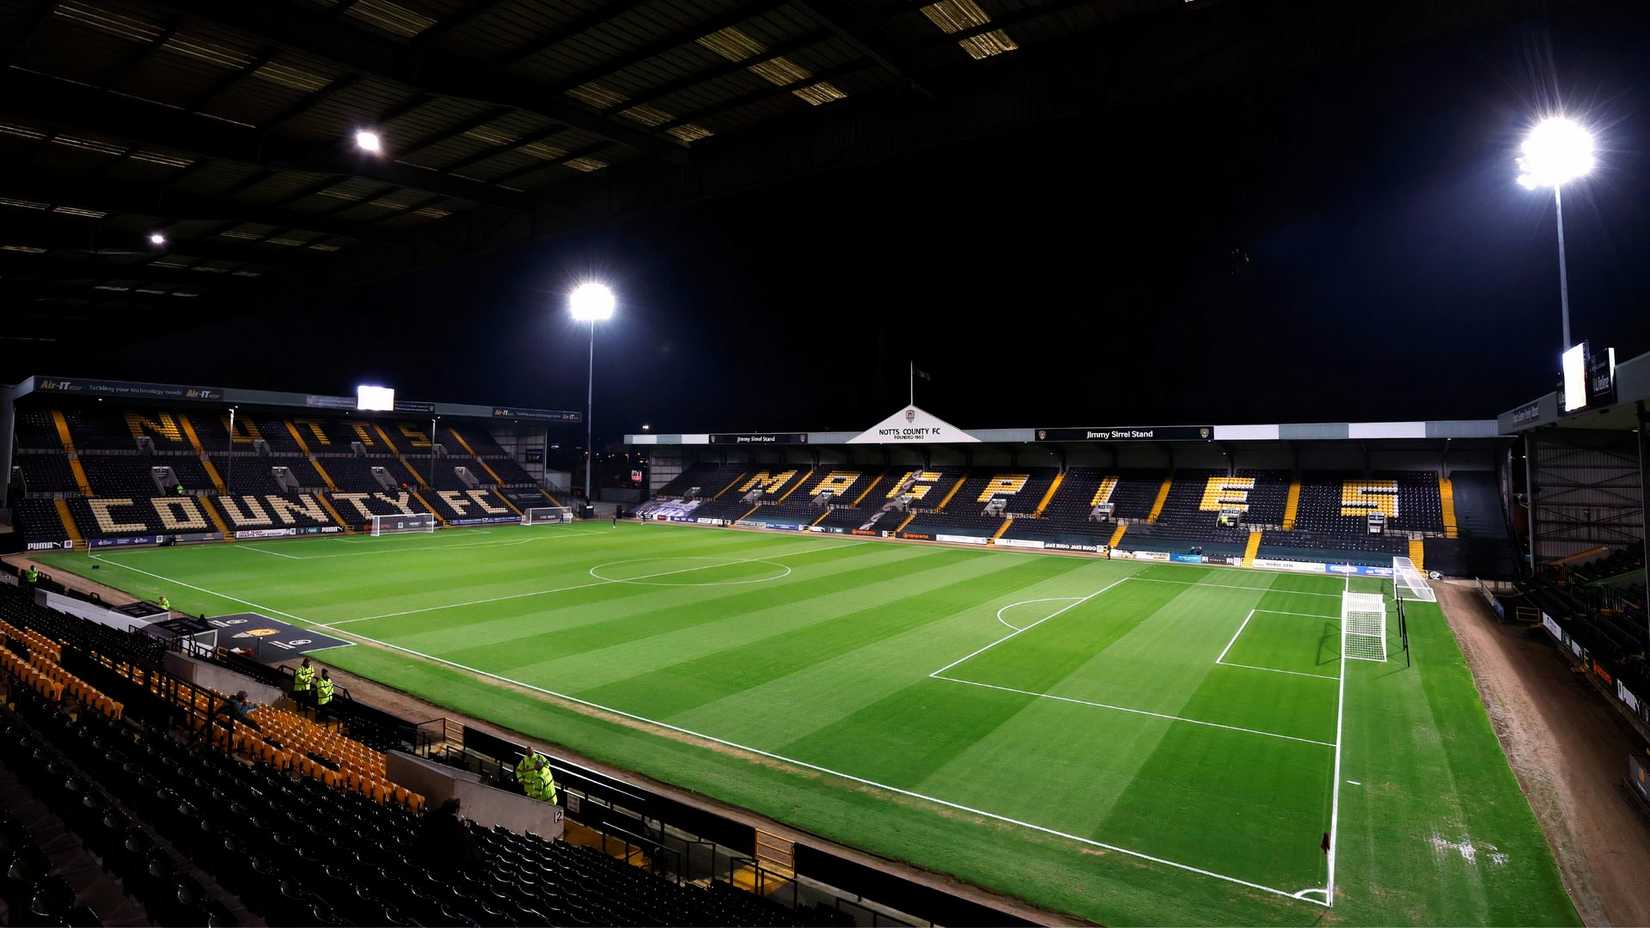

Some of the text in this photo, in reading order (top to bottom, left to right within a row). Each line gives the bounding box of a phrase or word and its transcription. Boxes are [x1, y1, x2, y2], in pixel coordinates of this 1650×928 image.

[737, 436, 750, 444] Jimmy
[763, 435, 775, 443] Stand
[1087, 430, 1153, 441] Jimmy Sirrel Stand
[88, 490, 508, 533] COUNTY FC
[27, 542, 53, 550] PUMA
